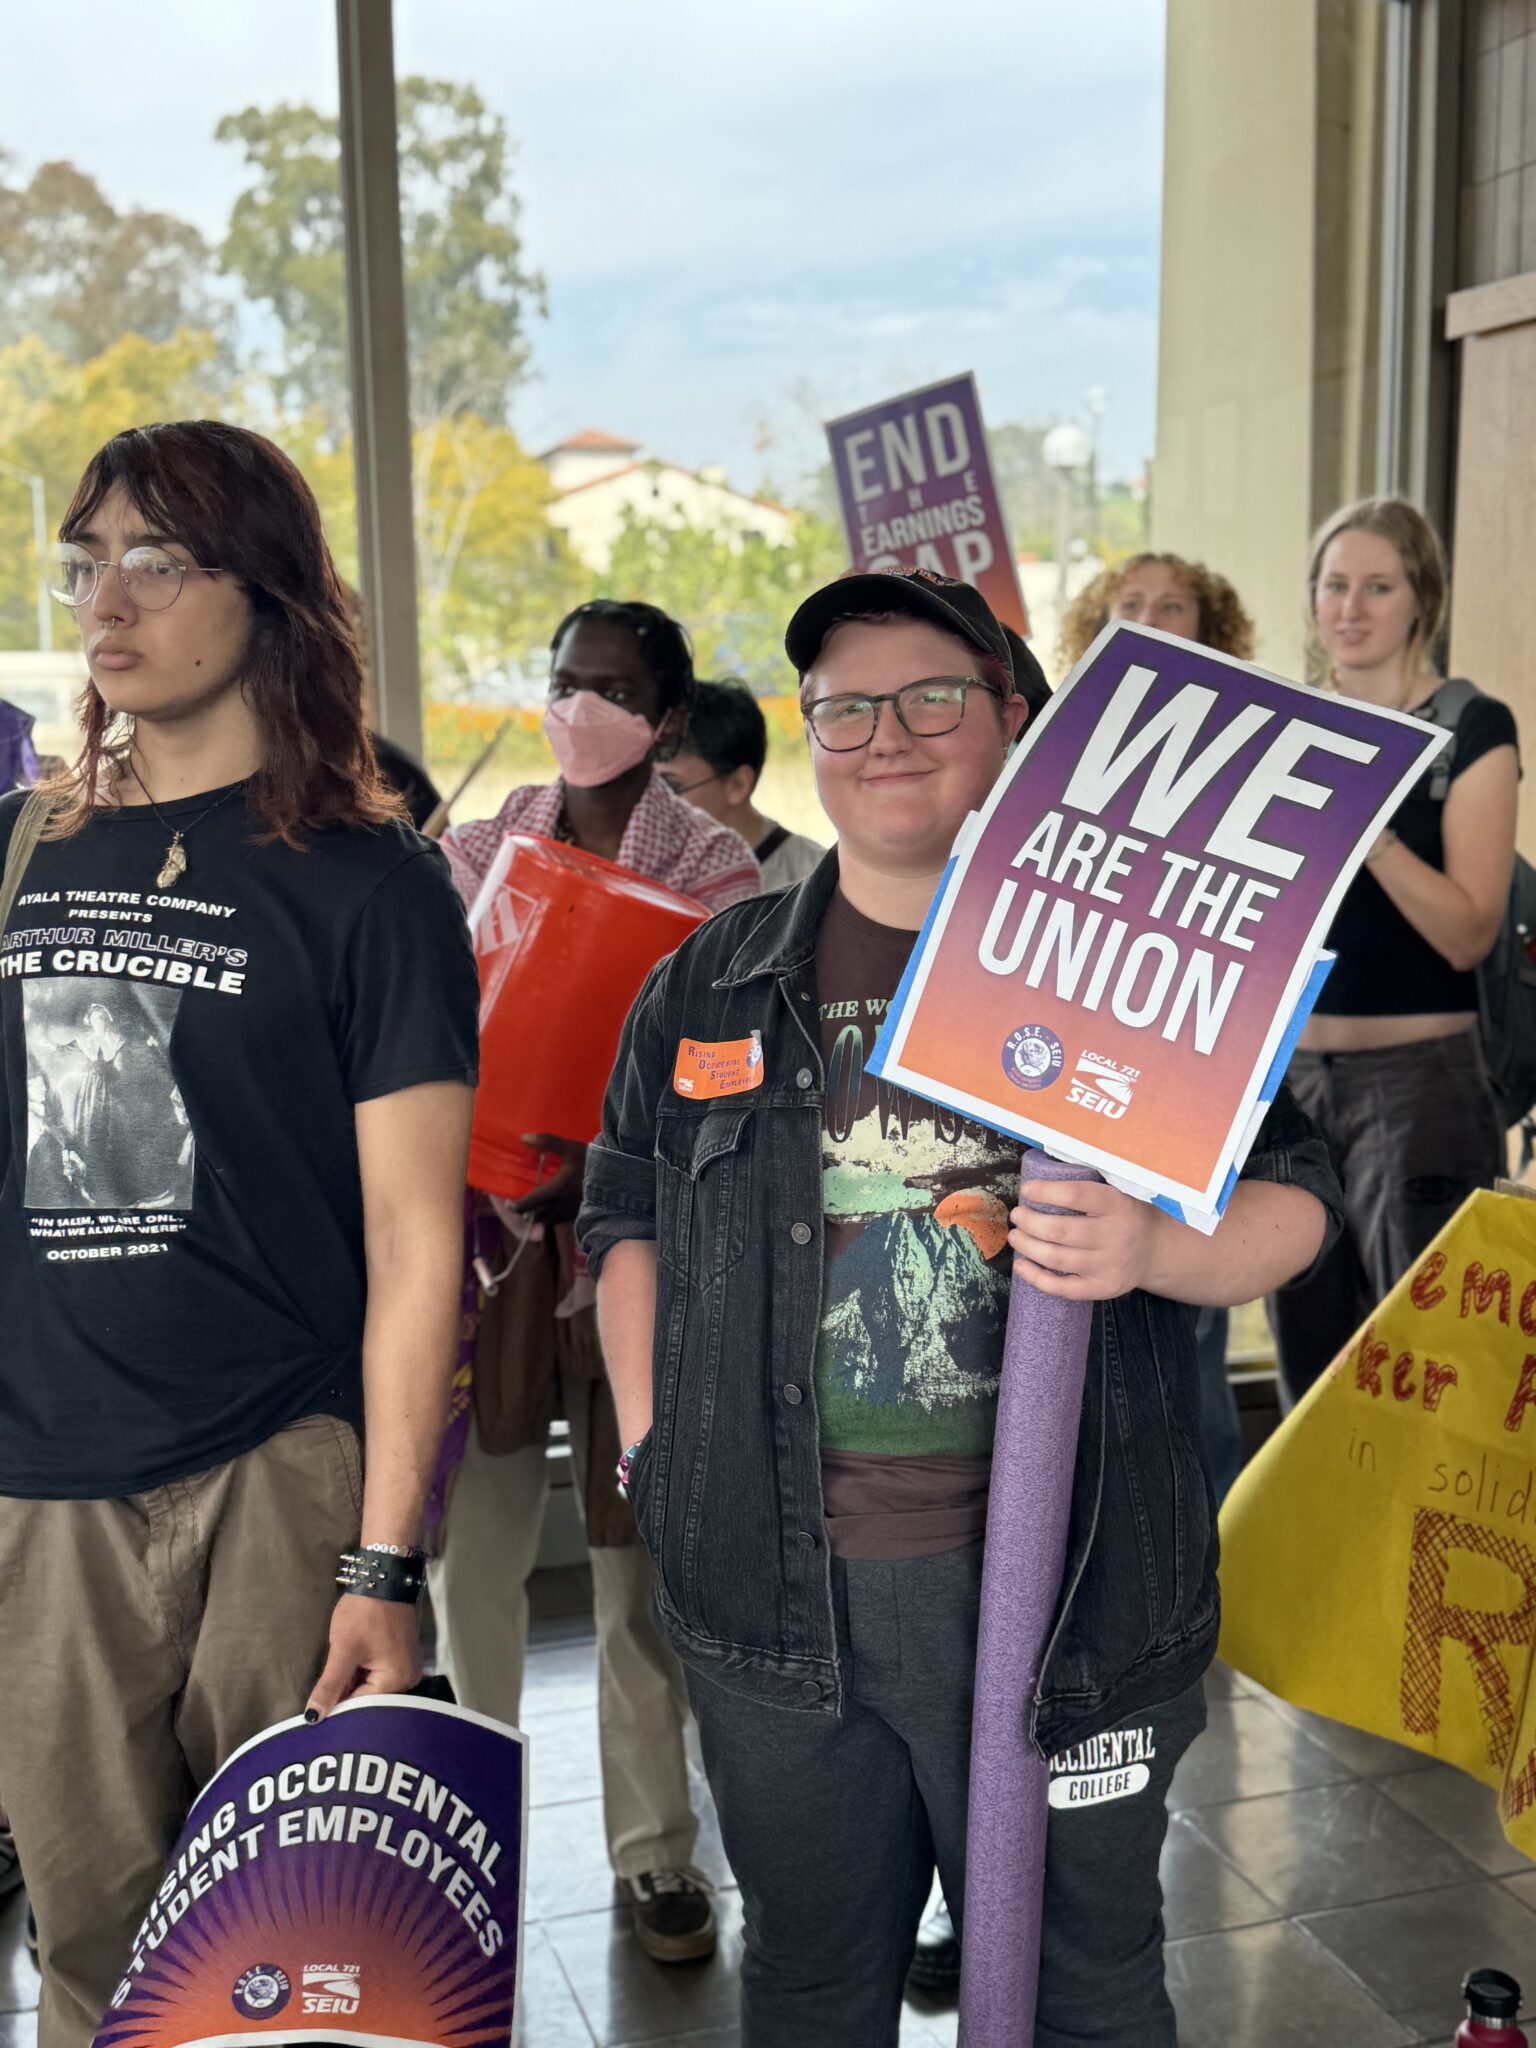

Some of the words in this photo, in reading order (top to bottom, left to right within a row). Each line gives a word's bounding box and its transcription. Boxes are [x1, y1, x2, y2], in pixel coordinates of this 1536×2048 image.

[844, 401, 971, 504] END
[860, 494, 987, 558] EARNINGS
[1061, 664, 1381, 881] WE
[1011, 811, 1148, 904] ARE
[1148, 850, 1280, 952] THE
[18, 891, 60, 907] AYALA
[66, 890, 142, 904] THEATRE
[146, 894, 237, 918] COMPANY
[68, 908, 153, 923] PRESENTS
[0, 950, 43, 979] THE
[52, 949, 246, 995] CRUCIBLE
[978, 878, 1245, 1056] UNION
[818, 1000, 859, 1021] THE
[1050, 1041, 1062, 1068] SEIU
[1081, 1049, 1118, 1070] LOCAL
[1120, 1065, 1141, 1079] 721
[1065, 1086, 1128, 1120] SEIU
[68, 1228, 86, 1236] WE
[47, 1246, 122, 1261] OCTOBER
[127, 1243, 168, 1256] 2021
[1349, 1428, 1376, 1472] in
[1049, 1725, 1156, 1773] CCIDENTAL
[1069, 1771, 1131, 1801] COLLEGE
[247, 1752, 502, 1886] OCCIDENTAL
[110, 1823, 265, 2009] STUDENT
[277, 1804, 504, 1958] EMPLOYEES
[303, 1964, 340, 1973] LOCAL
[342, 1964, 361, 1974] 721
[302, 1998, 361, 2015] SEIU
